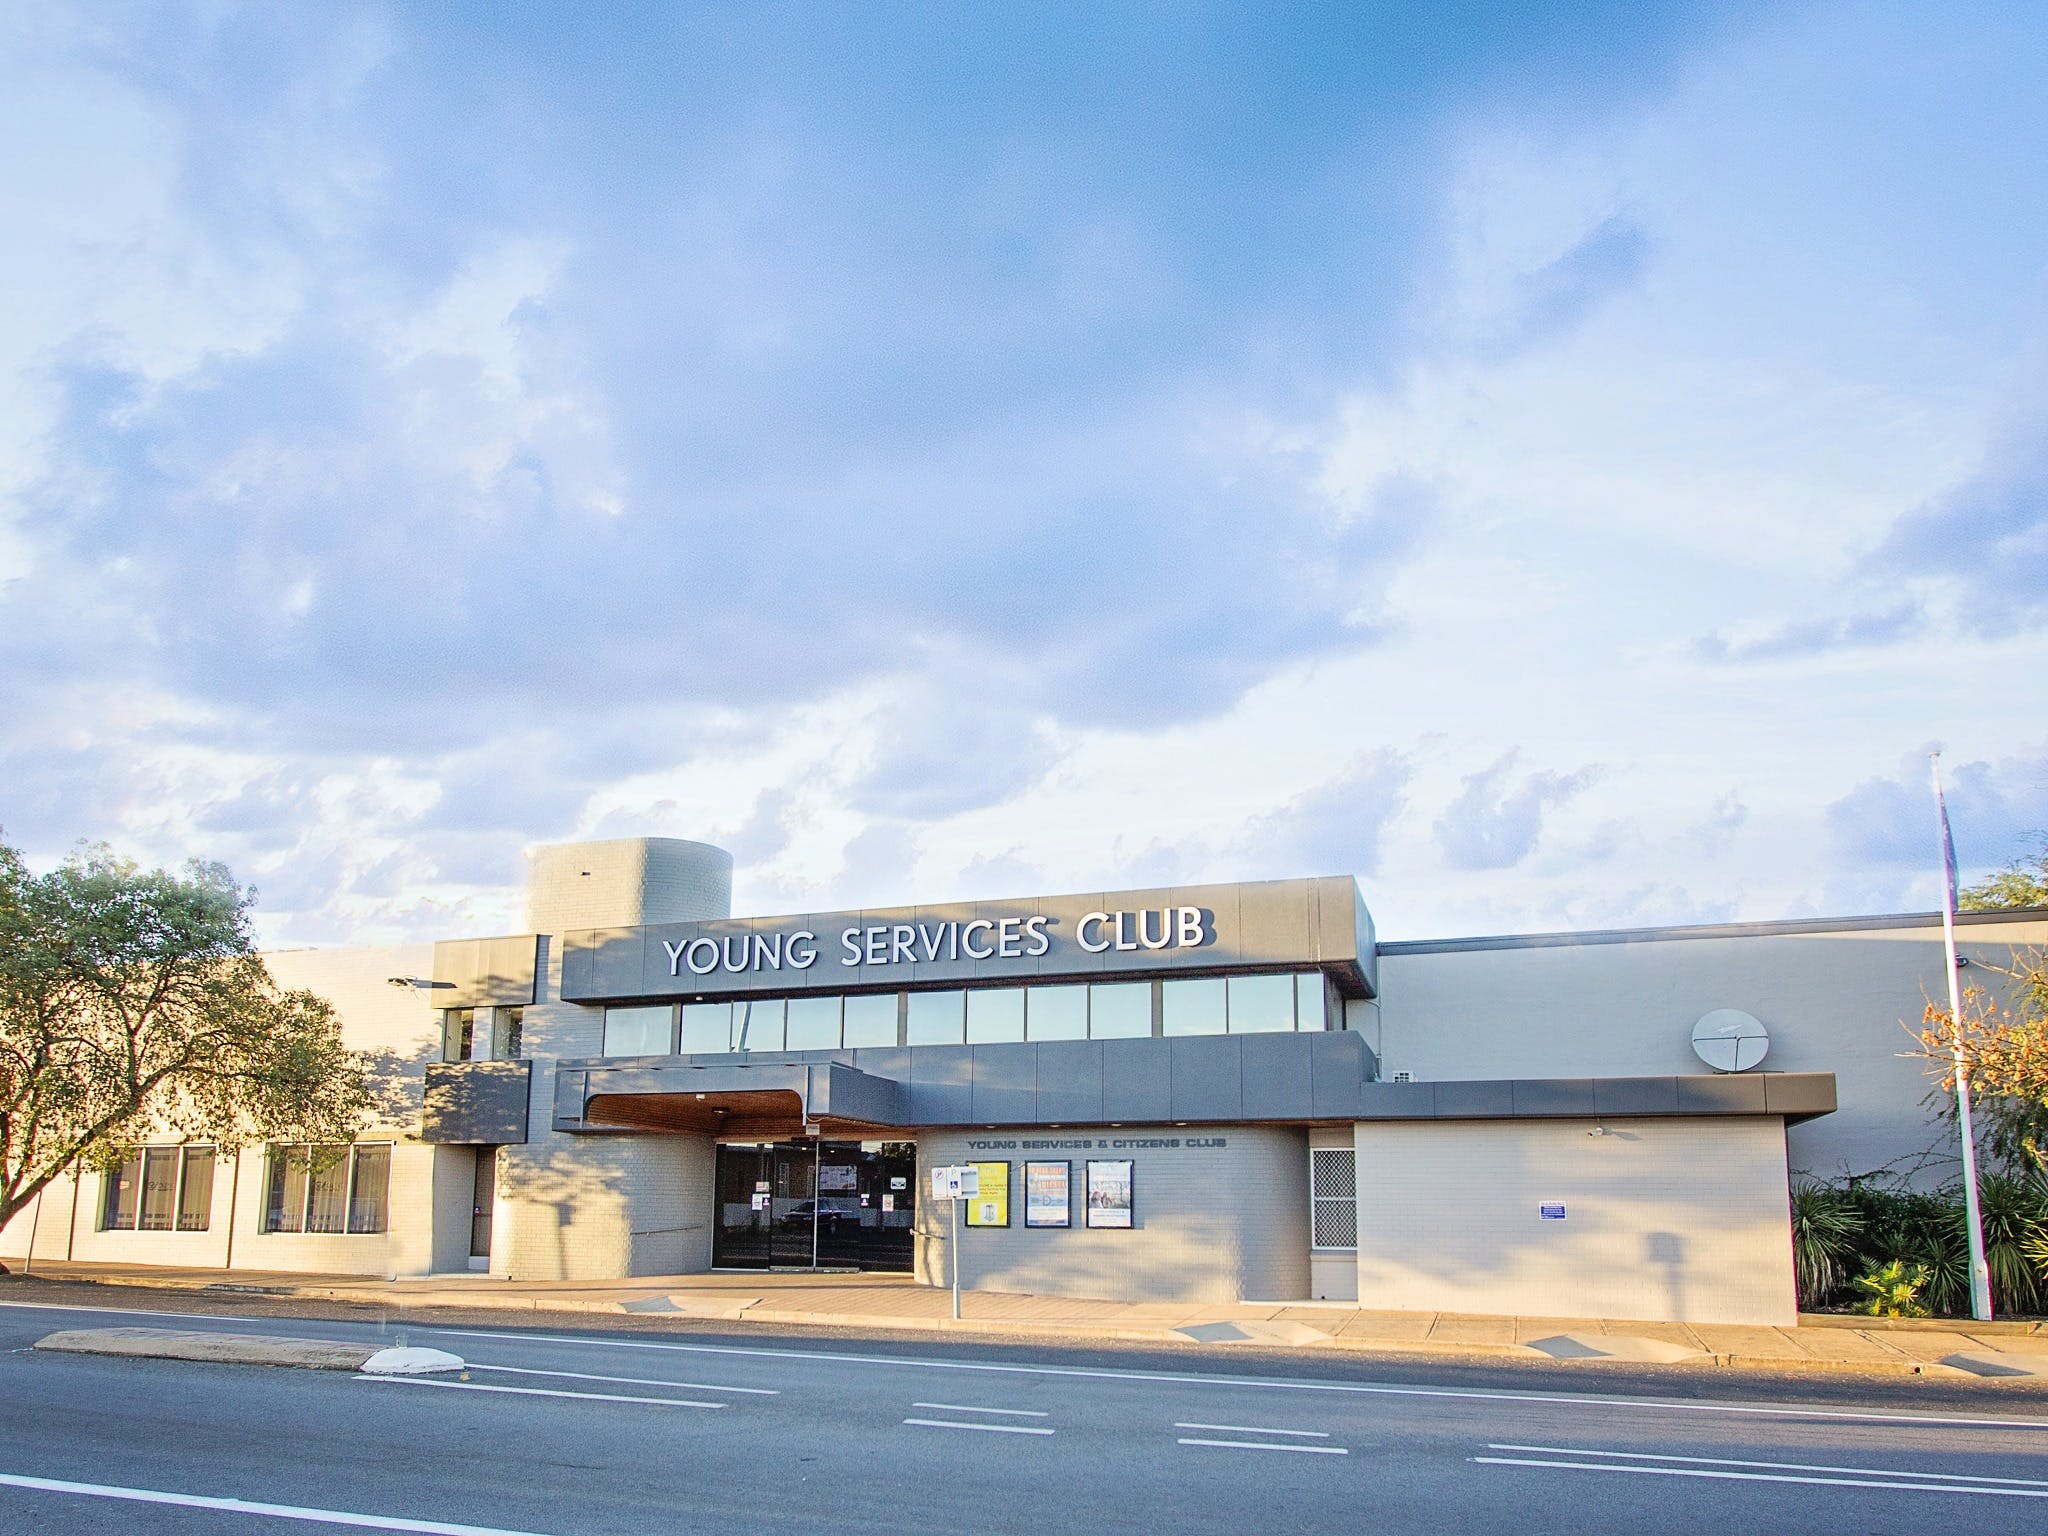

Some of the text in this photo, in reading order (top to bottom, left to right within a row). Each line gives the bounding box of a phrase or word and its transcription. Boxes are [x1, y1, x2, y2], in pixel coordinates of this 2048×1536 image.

[663, 905, 1205, 976] YOUNG SERVICES CLUB
[968, 1138, 1227, 1150] YOUNG SERVICES & CITIZENS CLUB
